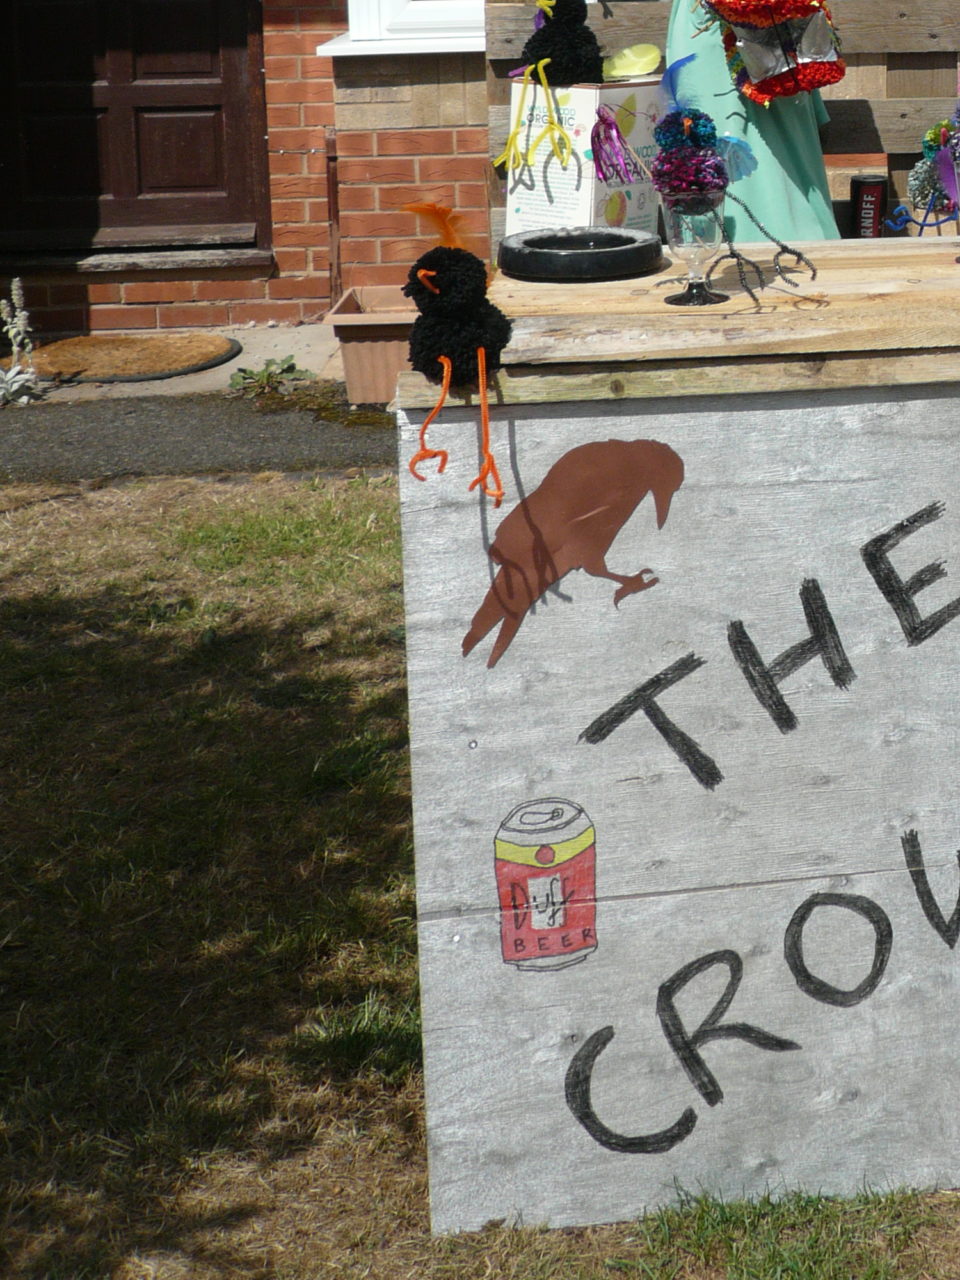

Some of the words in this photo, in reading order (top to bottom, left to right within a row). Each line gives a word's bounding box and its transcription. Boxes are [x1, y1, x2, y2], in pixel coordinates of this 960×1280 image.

[526, 113, 576, 127] ORGNIC
[510, 876, 576, 931] Duff
[513, 927, 593, 954] BEER
